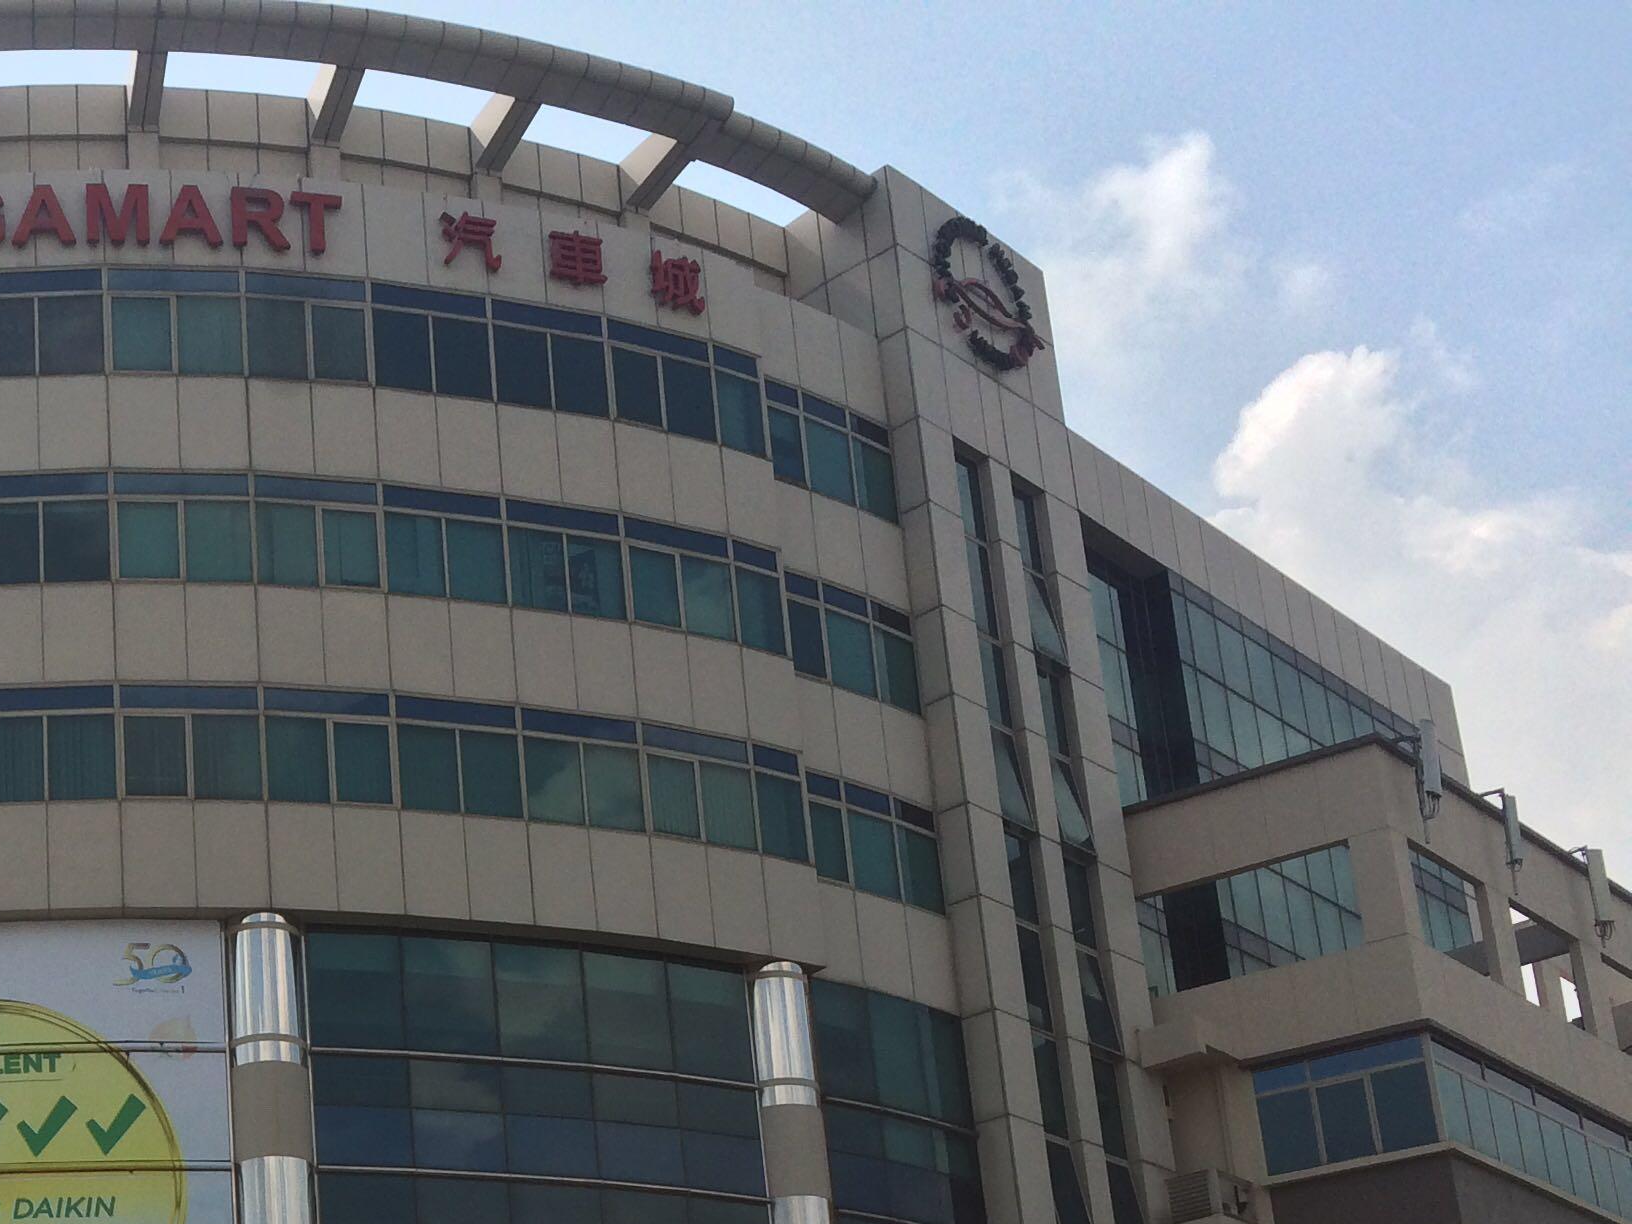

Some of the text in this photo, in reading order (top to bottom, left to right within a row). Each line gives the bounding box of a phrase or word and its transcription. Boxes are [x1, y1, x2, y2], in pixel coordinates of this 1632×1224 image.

[439, 210, 706, 317] 汽車城
[12, 1195, 117, 1220] DAIKIN
